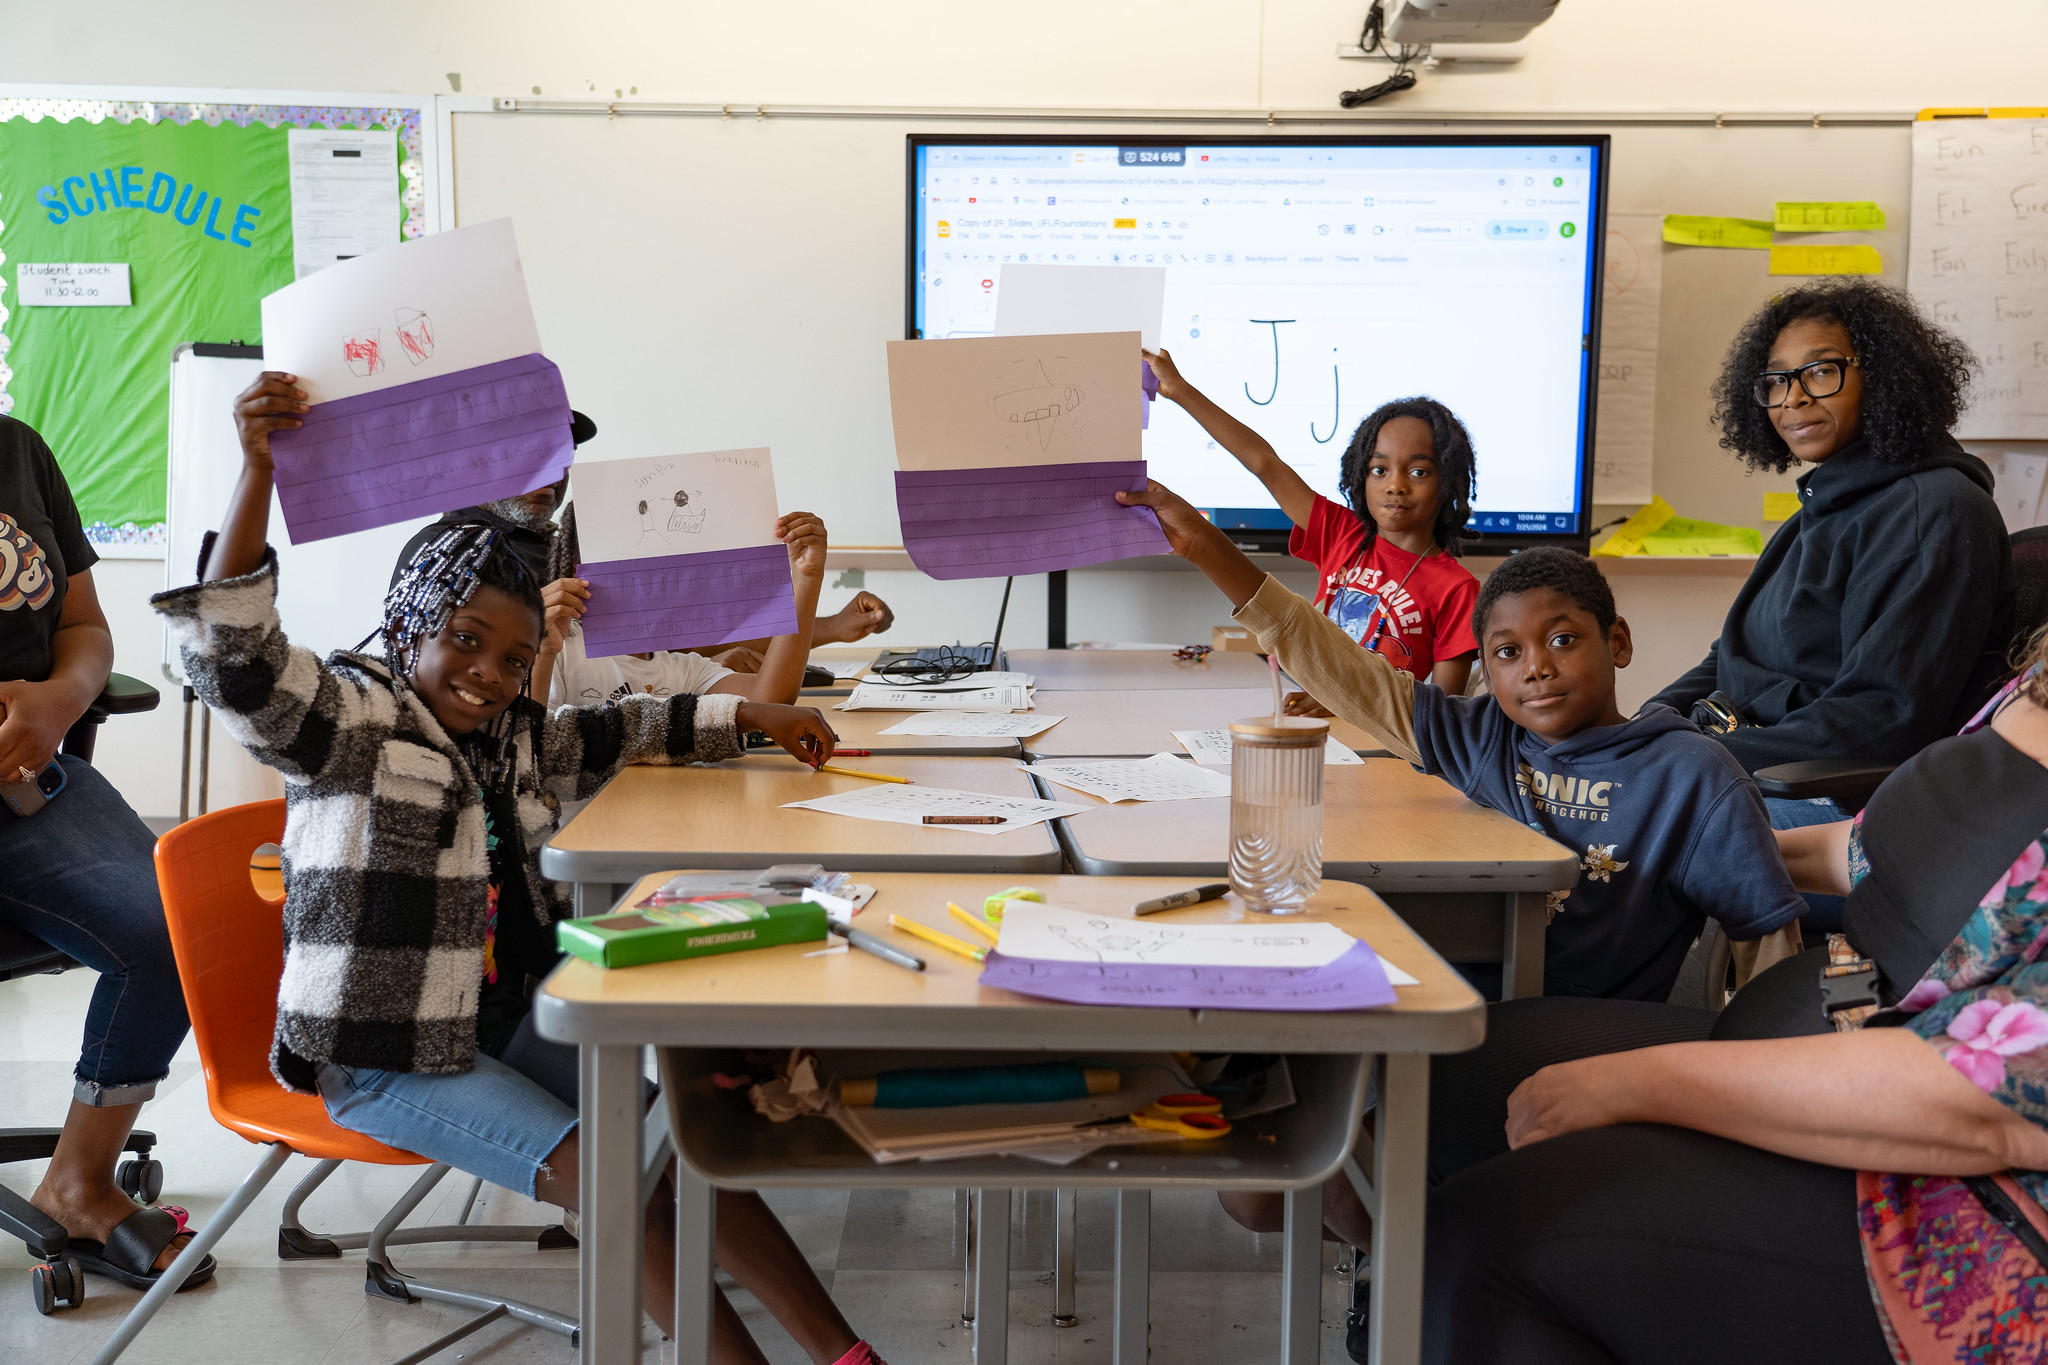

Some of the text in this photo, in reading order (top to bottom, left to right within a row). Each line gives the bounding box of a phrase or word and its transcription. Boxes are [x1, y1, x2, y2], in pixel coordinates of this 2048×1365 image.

[1139, 152, 1181, 163] 524 698
[1937, 135, 1984, 160] Fun
[37, 165, 261, 249] SCHEDULE
[957, 218, 980, 229] Copy
[983, 218, 992, 228] of
[1505, 226, 1528, 234] Share
[22, 263, 111, 276] Student Lunch
[1245, 318, 1297, 406] J
[1311, 347, 1340, 444] j
[1376, 579, 1423, 635] RULE!
[1515, 762, 1613, 807] SONIC
[1535, 800, 1610, 823] HEDGEHOG
[686, 929, 758, 950] TICONDEROGA
